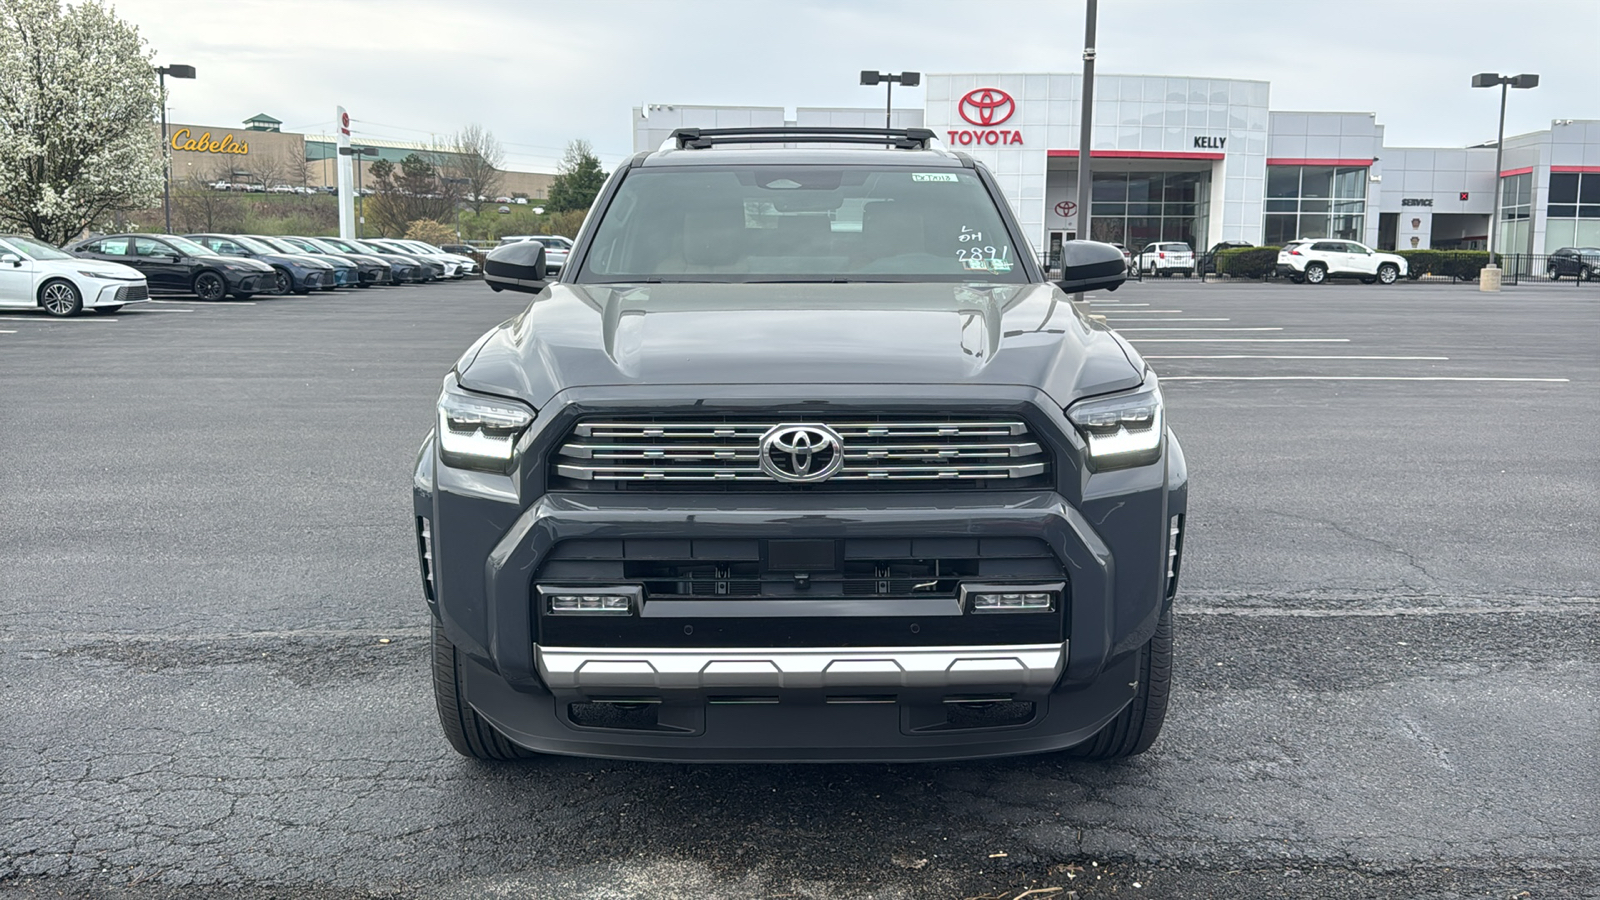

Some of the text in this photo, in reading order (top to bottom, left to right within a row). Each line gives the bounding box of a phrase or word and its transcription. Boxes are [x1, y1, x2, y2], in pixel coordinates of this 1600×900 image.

[171, 128, 249, 154] Cabela's
[947, 130, 1024, 145] TOYOTA
[1193, 136, 1227, 149] KELLY
[1401, 198, 1433, 207] SERVICE
[956, 245, 1008, 262] 2891
